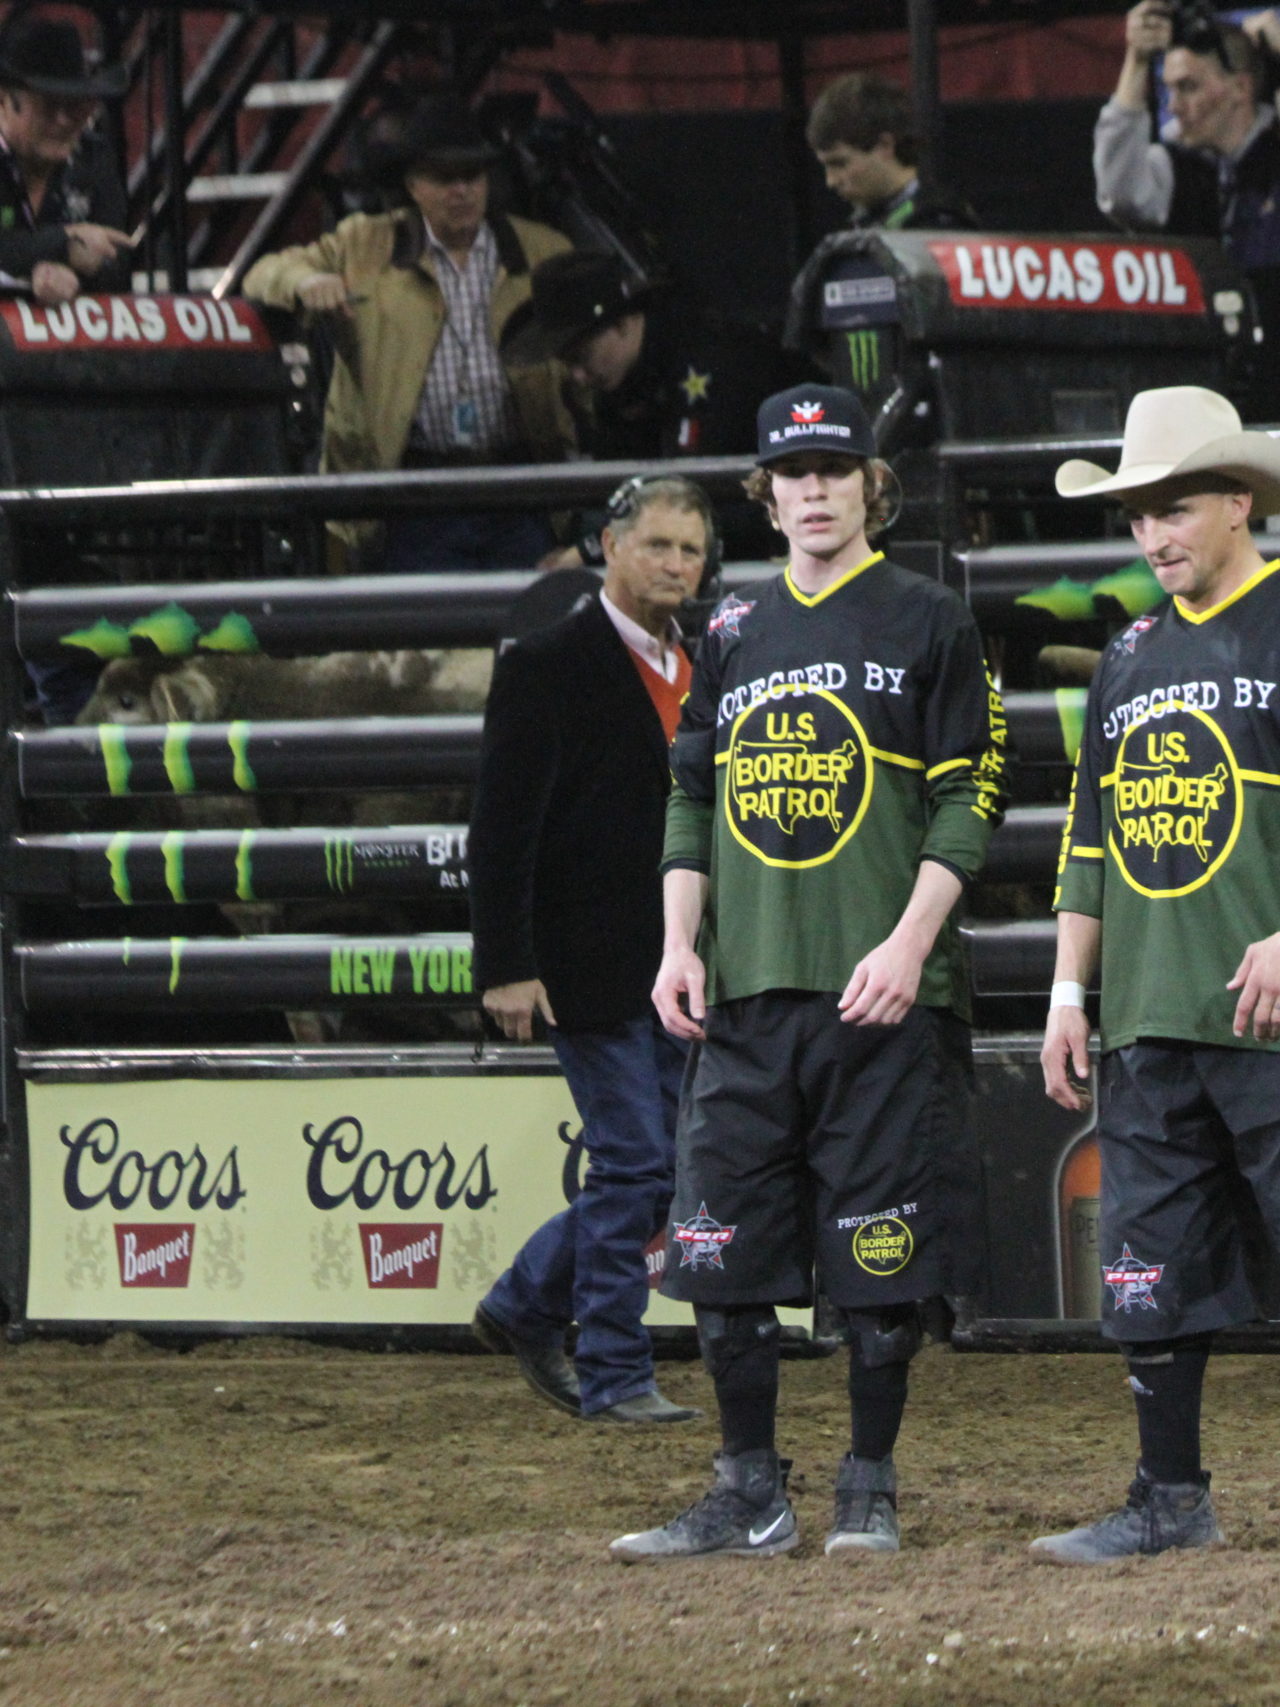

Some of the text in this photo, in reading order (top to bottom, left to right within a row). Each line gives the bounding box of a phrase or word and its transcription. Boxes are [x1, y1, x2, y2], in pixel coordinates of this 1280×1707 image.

[956, 245, 1104, 304] LUCAS
[1112, 250, 1187, 305] OIL
[16, 297, 252, 342] LUCAS OIL
[717, 660, 906, 728] OTECTED BY
[1233, 676, 1277, 710] BY
[766, 712, 817, 741] U.S.
[735, 752, 849, 787] BORDER
[739, 786, 844, 822] PATROL
[1123, 811, 1213, 848] PAROL
[330, 944, 473, 994] NEW YOR
[60, 1117, 247, 1211] Coors
[302, 1115, 497, 1211] Coors
[902, 1202, 918, 1215] BY
[123, 1230, 190, 1282] Banquet
[369, 1230, 437, 1282] Banquet
[860, 1236, 906, 1249] BORDER
[861, 1247, 905, 1260] PATROL
